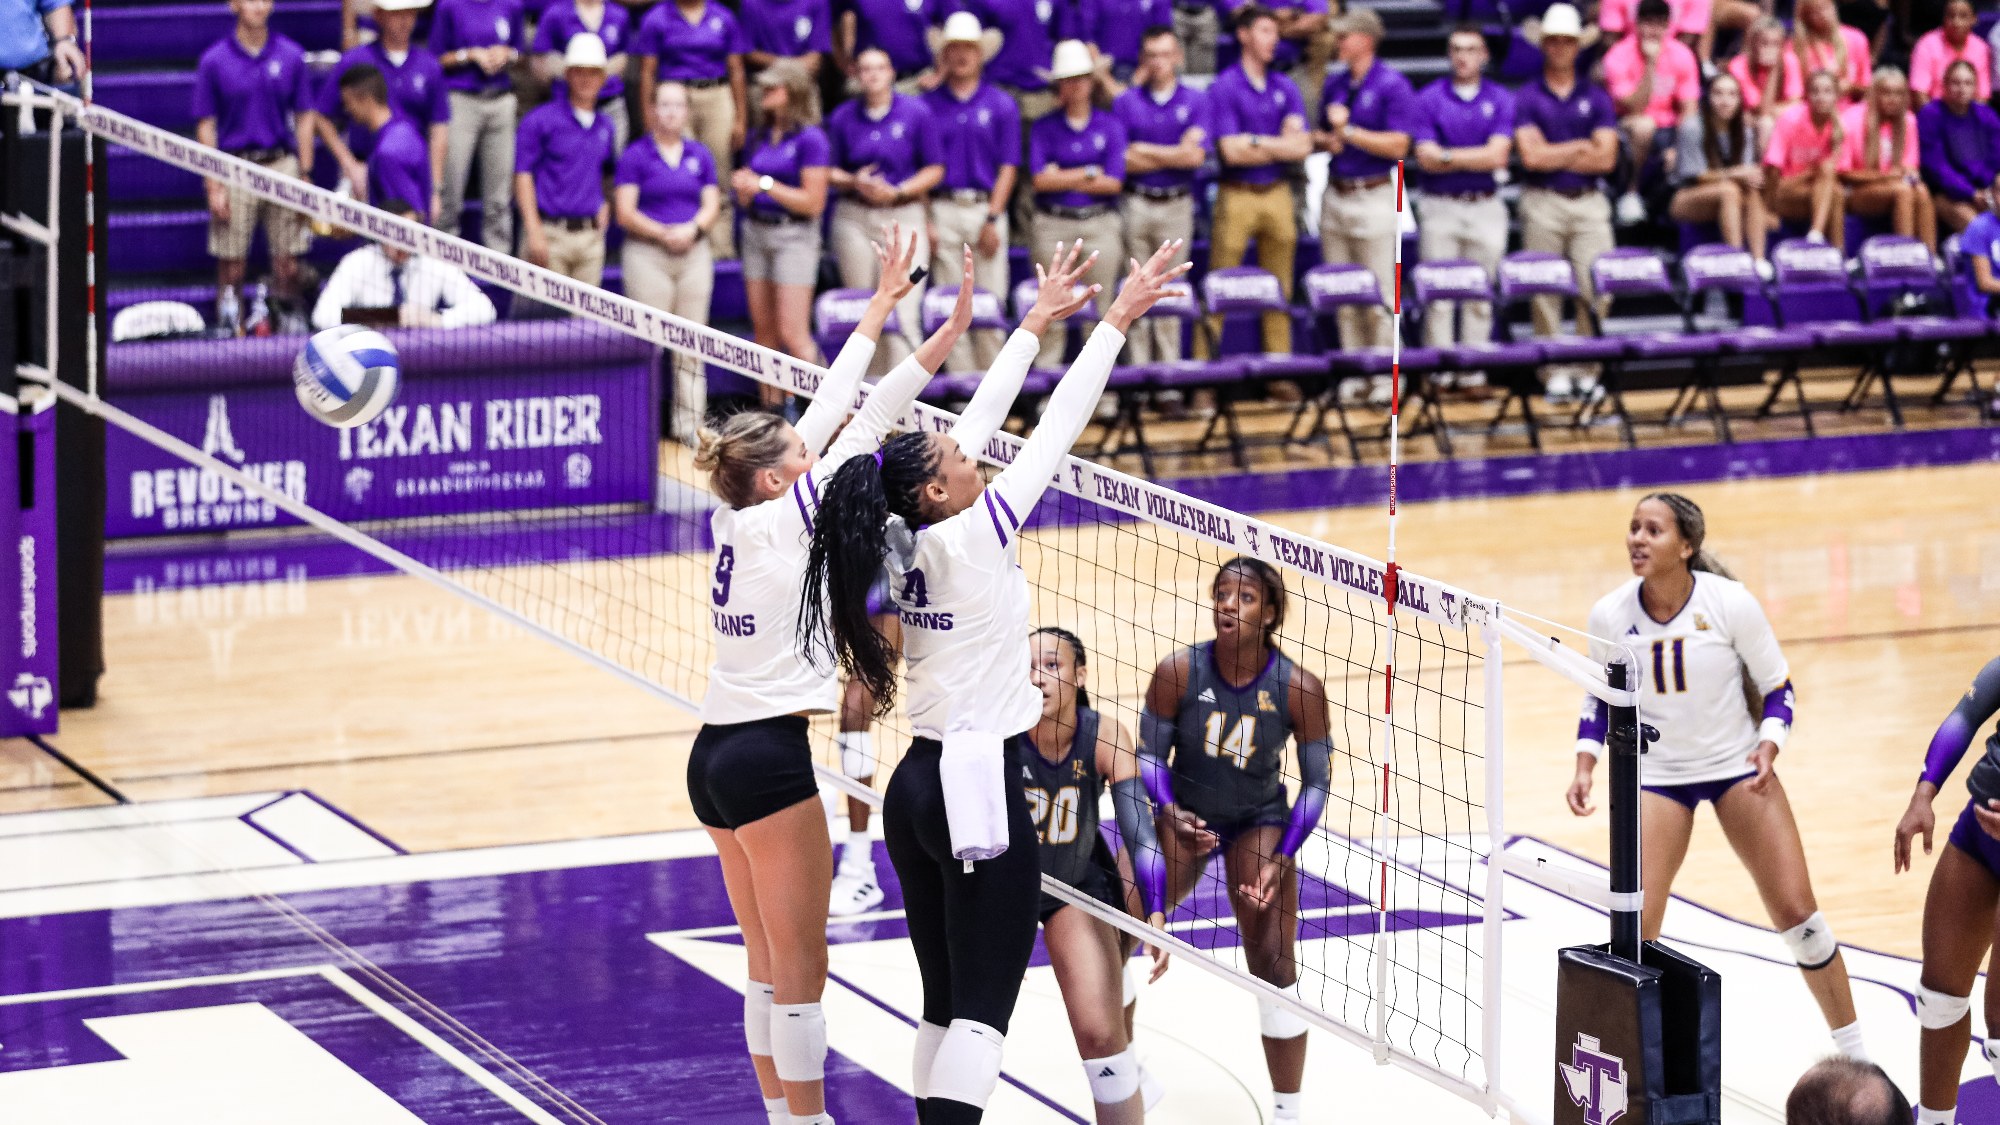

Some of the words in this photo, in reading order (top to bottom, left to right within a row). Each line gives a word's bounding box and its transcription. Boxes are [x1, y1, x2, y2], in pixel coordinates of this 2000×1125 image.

[485, 393, 602, 451] RIDER
[131, 460, 307, 519] REVOLVER
[660, 319, 697, 351] TEXAN
[697, 333, 765, 375] VOLLEYBALL
[790, 364, 824, 394] TEXA
[1093, 471, 1141, 511] TEXAN
[1144, 489, 1236, 545] VOLLEYBALL
[1269, 533, 1326, 577] TEXAN
[1328, 553, 1430, 614] VOLLEALL
[163, 499, 277, 530] BREWING
[712, 543, 736, 608] 9
[710, 608, 756, 637] XANS
[1650, 637, 1688, 695] 11
[1203, 710, 1258, 771] 14
[1023, 785, 1081, 845] 20
